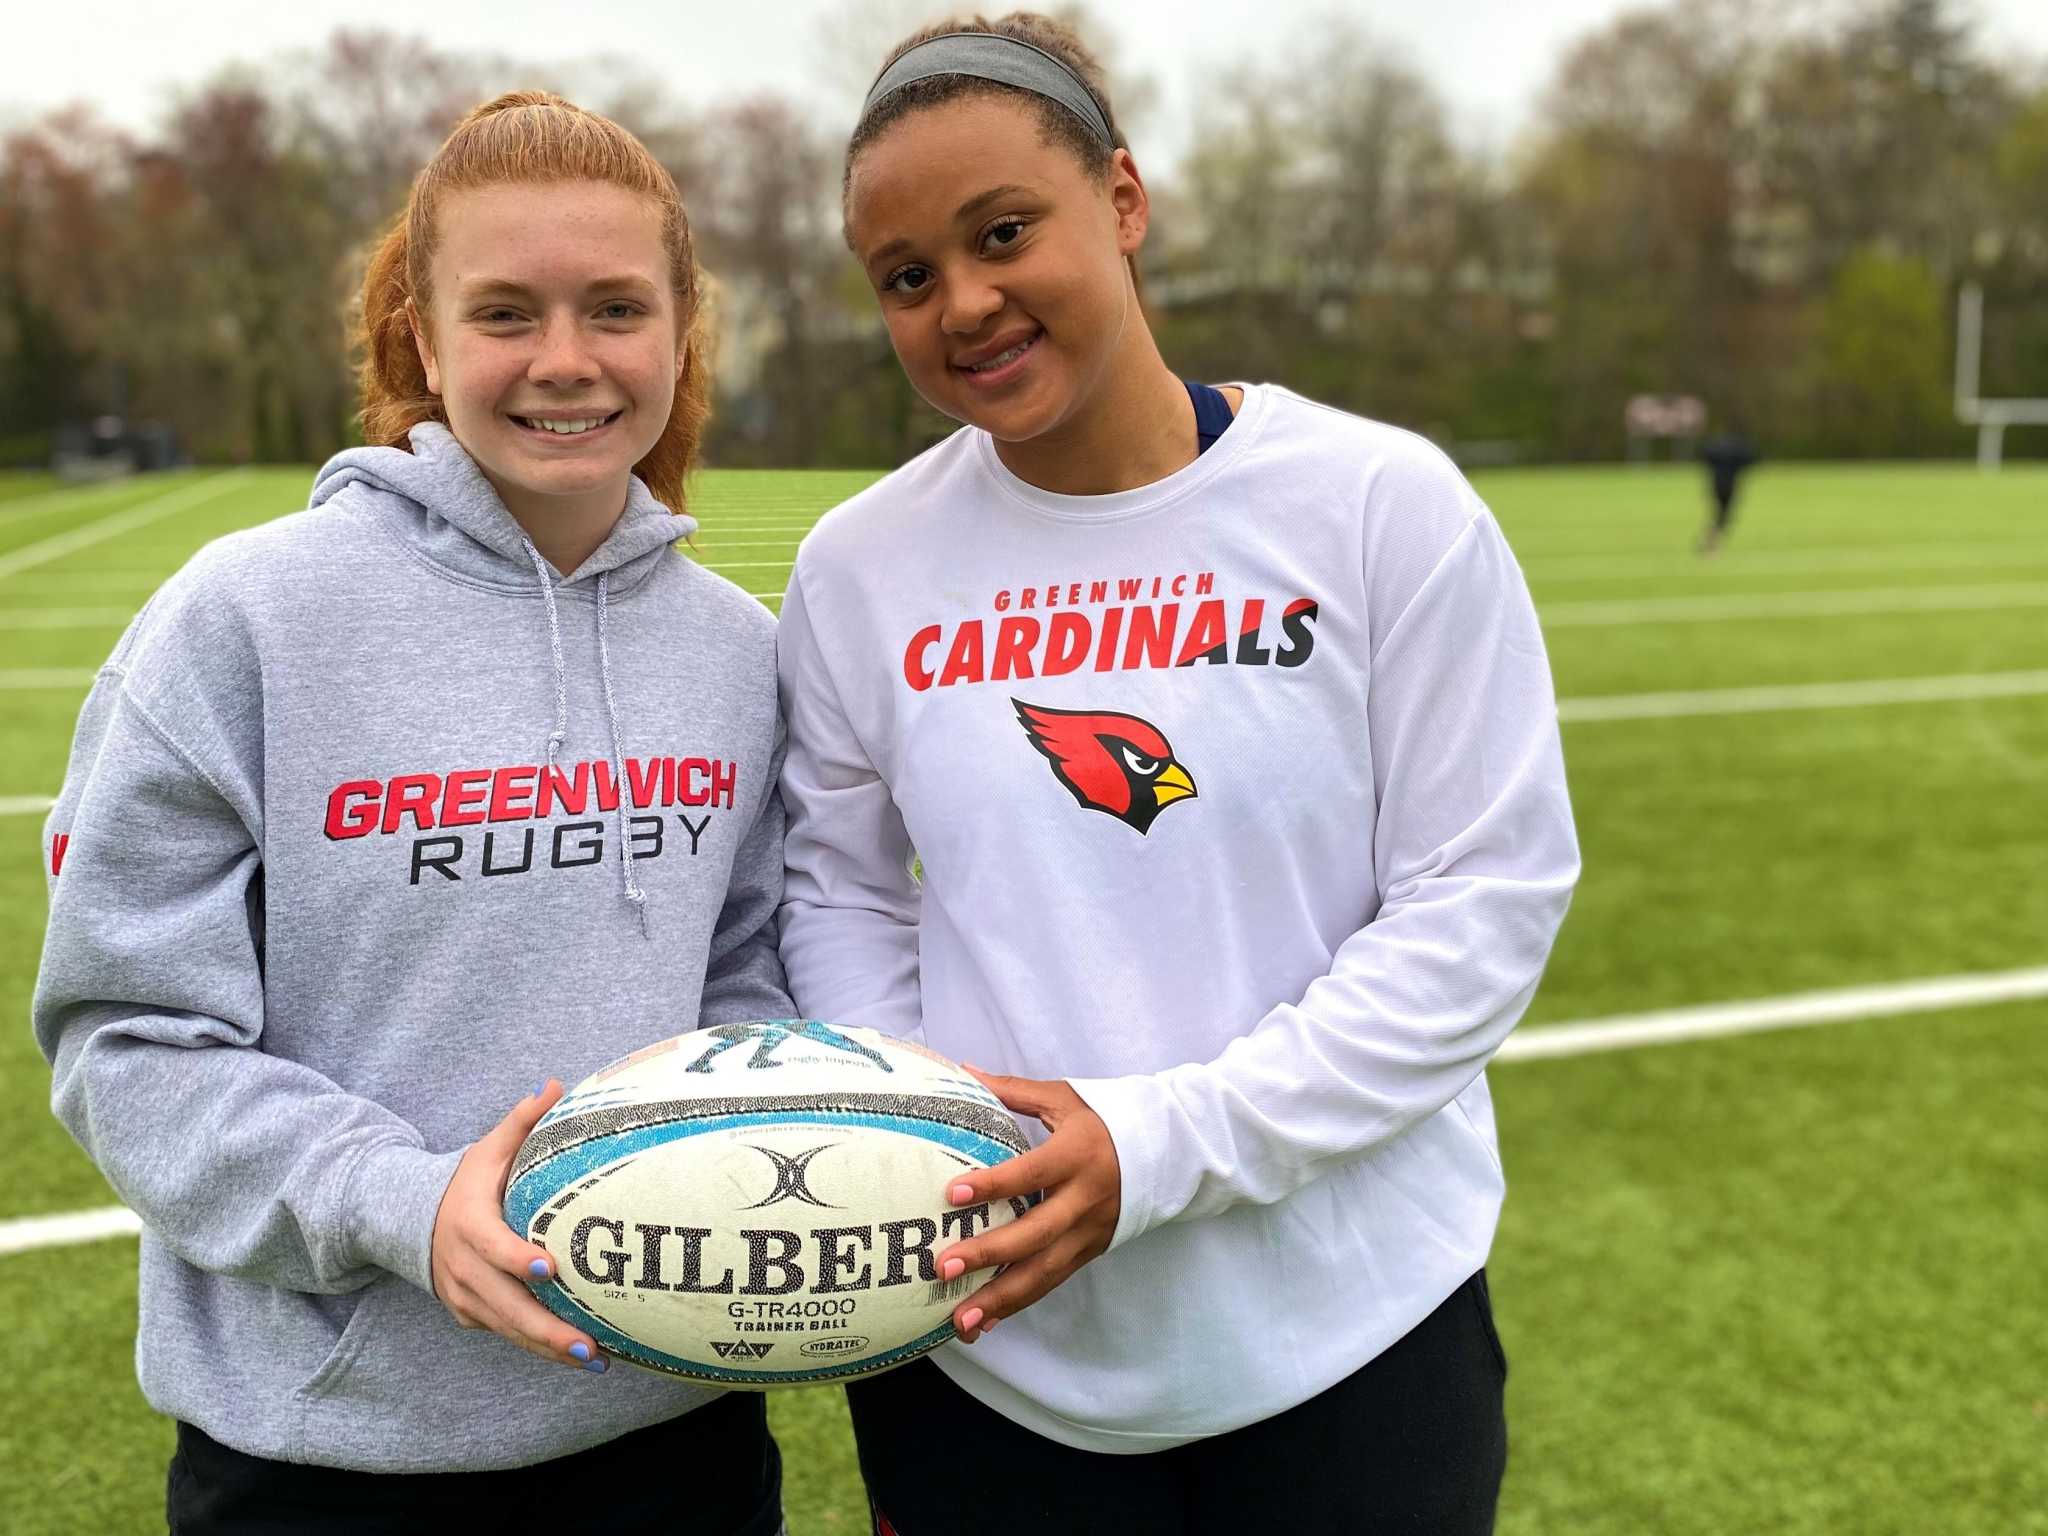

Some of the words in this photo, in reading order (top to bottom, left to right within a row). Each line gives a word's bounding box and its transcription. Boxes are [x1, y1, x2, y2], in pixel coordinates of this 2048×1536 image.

[994, 572, 1215, 612] GREENWICH
[904, 597, 1319, 692] CARDINALS
[324, 757, 736, 841] GREENWICH
[409, 814, 711, 886] RUGBY
[570, 1202, 990, 1296] GILBERT
[604, 1289, 628, 1301] SIZE
[728, 1298, 856, 1318] G-TR4000
[734, 1321, 805, 1332] TRAINER
[809, 1318, 848, 1330] BALL
